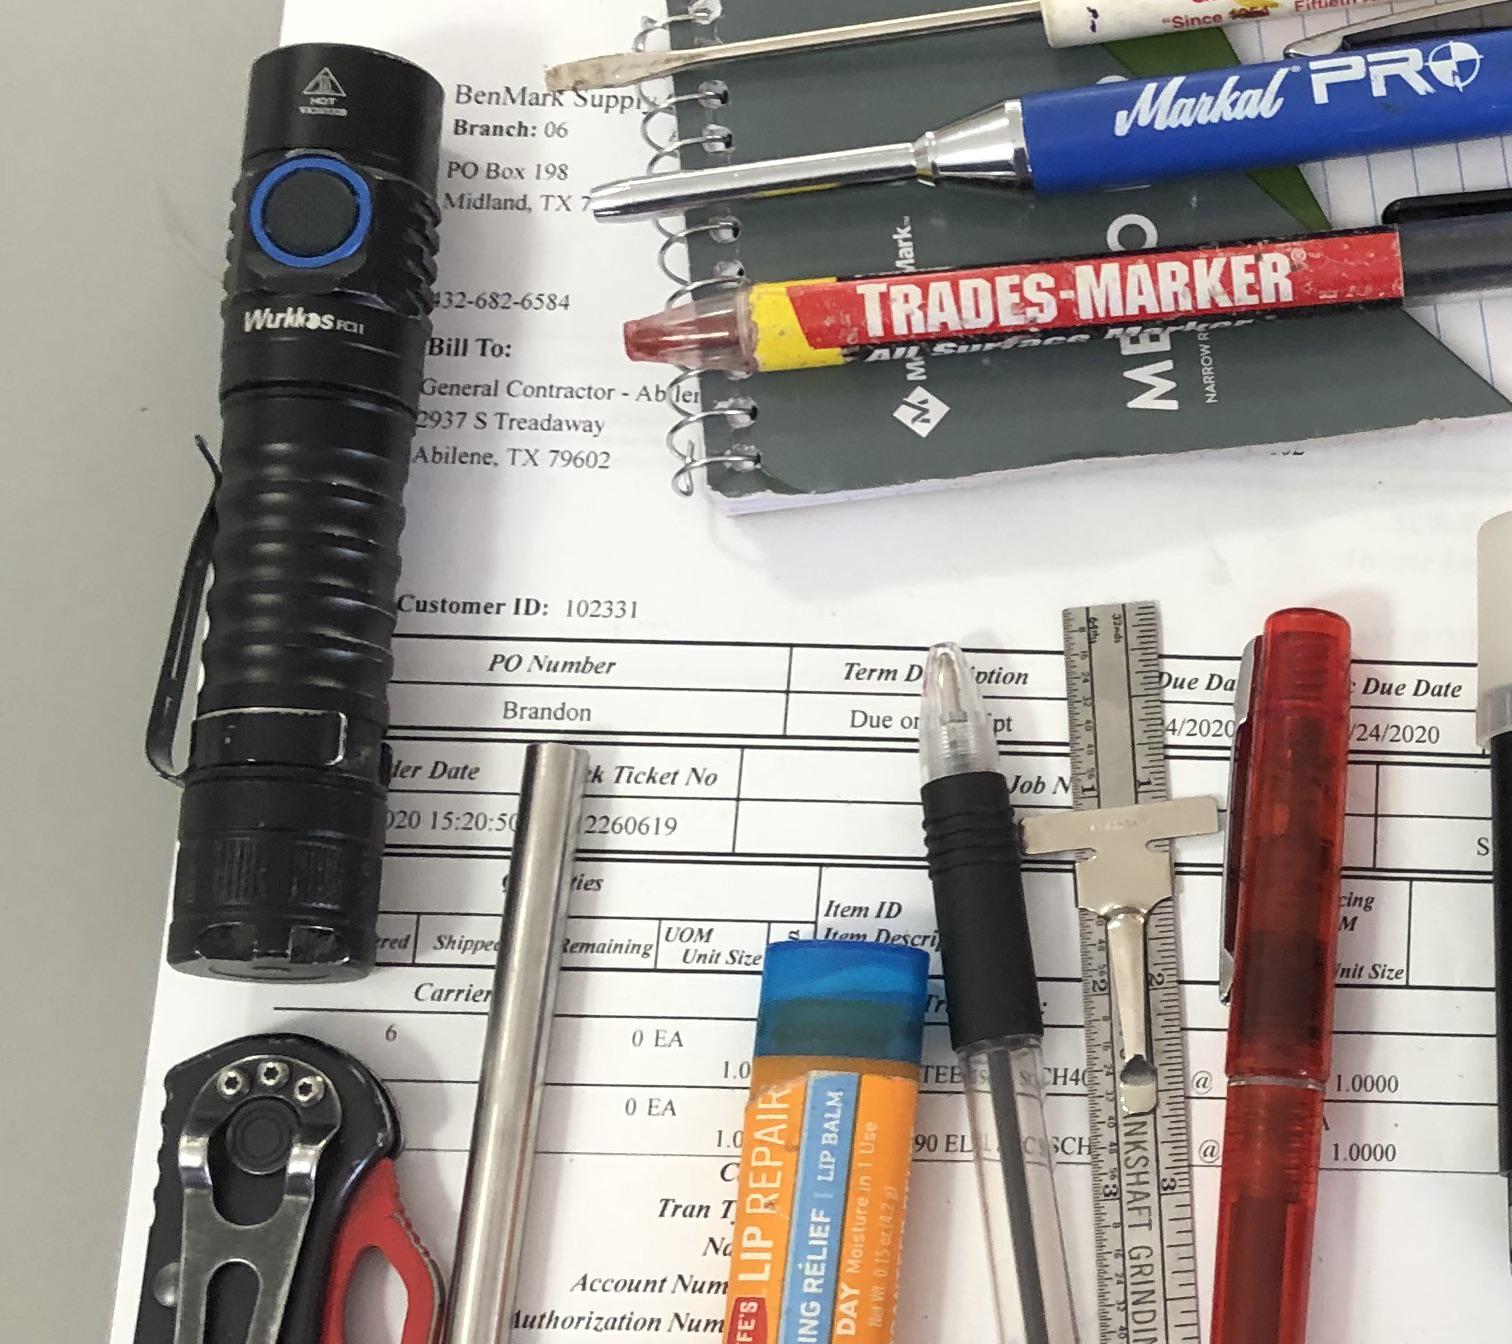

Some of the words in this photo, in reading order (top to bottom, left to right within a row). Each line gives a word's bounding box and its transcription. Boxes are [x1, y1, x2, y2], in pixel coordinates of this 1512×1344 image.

[455, 84, 565, 107] BenMark
[1113, 67, 1291, 137] Markal
[1308, 39, 1485, 106] PRO
[453, 119, 537, 139] Branch:
[543, 121, 569, 139] 06
[446, 161, 479, 180] PO
[486, 161, 526, 180] Box
[536, 162, 569, 181] 198
[442, 193, 533, 213] Midland,
[539, 194, 573, 212] TX
[856, 251, 1294, 339] TRADES-MARKER
[427, 337, 469, 357] Bill
[475, 337, 512, 358] To:
[1200, 342, 1219, 404] NARROW
[420, 378, 500, 398] General
[505, 379, 616, 402] Contractor
[416, 411, 466, 431] 2937
[473, 412, 488, 431] S
[495, 412, 606, 438] Treadaway
[412, 446, 499, 468] Abilene,
[505, 447, 541, 467] TX
[548, 448, 612, 470] 79602
[396, 594, 507, 617] Customer
[512, 596, 550, 618] ID:
[565, 598, 640, 620] 102331
[487, 653, 524, 674] PO
[526, 654, 617, 677] Number
[843, 662, 898, 683] Term
[1361, 677, 1408, 697] Due
[1412, 678, 1464, 699] Date
[501, 699, 593, 724] Brandon
[850, 709, 894, 732] Due
[427, 760, 482, 781] Date
[612, 764, 680, 787] Ticket
[684, 766, 718, 788] No
[823, 900, 870, 919] Item
[874, 900, 903, 920] ID
[664, 925, 715, 945] UOM
[681, 948, 721, 966] Unit
[724, 949, 764, 967] Size
[1368, 962, 1405, 981] Size
[385, 1025, 397, 1042] 6
[632, 1029, 644, 1047] 0
[654, 1029, 685, 1047] EA
[1193, 1071, 1215, 1095] @
[1335, 1073, 1400, 1094] 1.0000
[625, 1098, 637, 1117] 0
[647, 1098, 678, 1117] EA
[821, 1090, 845, 1146] BALM
[859, 1121, 879, 1155] Use
[744, 1086, 793, 1215] REPAIR
[1332, 1142, 1397, 1163] 1.0000
[819, 1149, 839, 1182] LIP
[1122, 1112, 1154, 1231] NKSHAFT
[658, 1198, 711, 1220] Tran
[845, 1196, 870, 1274] Moisture
[737, 1225, 775, 1282] LIP
[800, 1207, 832, 1294] RELIEF
[569, 1274, 668, 1296] Account
[836, 1280, 861, 1336] DAY
